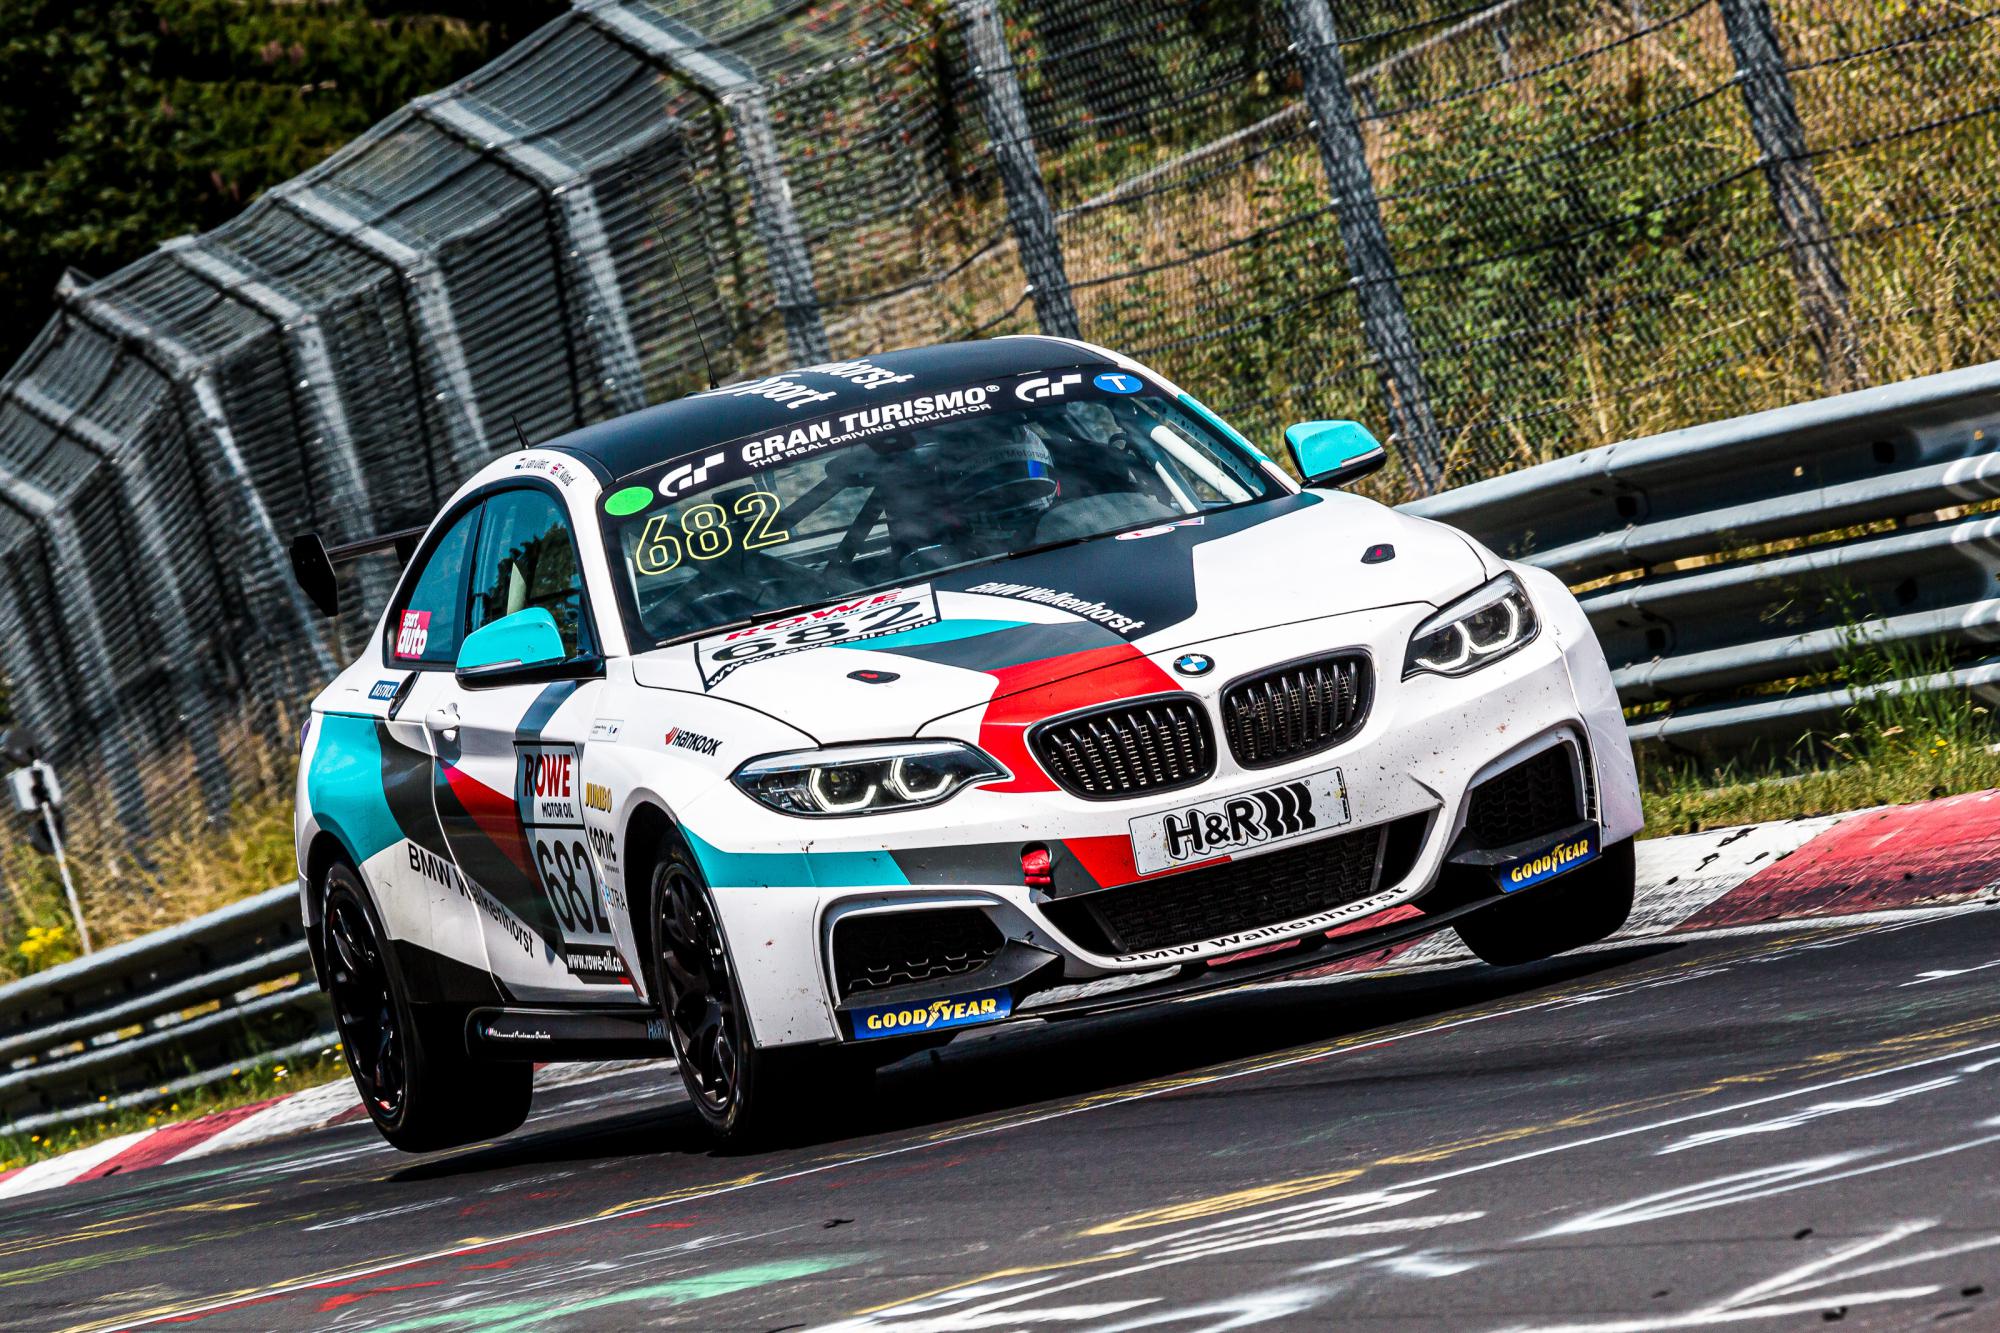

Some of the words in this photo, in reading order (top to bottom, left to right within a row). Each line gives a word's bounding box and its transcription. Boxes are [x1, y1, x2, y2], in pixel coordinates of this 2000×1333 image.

[1101, 375, 1126, 391] T
[741, 420, 831, 462] GRAN
[749, 454, 783, 469] THE
[786, 439, 828, 459] REAL
[830, 423, 896, 444] DRIVING
[900, 403, 992, 427] SIMULATOR
[636, 491, 790, 576] 682
[712, 601, 923, 661] 682
[724, 589, 903, 641] ROWE
[965, 582, 1026, 597] BMW
[1020, 586, 1146, 635] Walkenhorst
[397, 624, 428, 656] auto
[708, 617, 938, 686] www.rowe-oil.com
[523, 753, 572, 798] ROWE
[584, 782, 614, 814] JUMBO
[541, 802, 563, 819] MOTOR
[564, 803, 575, 819] OIL
[536, 839, 613, 934] 682
[1511, 839, 1589, 883] GOODYEAR
[407, 841, 452, 890] BMW
[453, 866, 534, 959] Walkenhorst
[1211, 887, 1408, 949] Walkenhorst
[867, 998, 997, 1030] GOODYEAR
